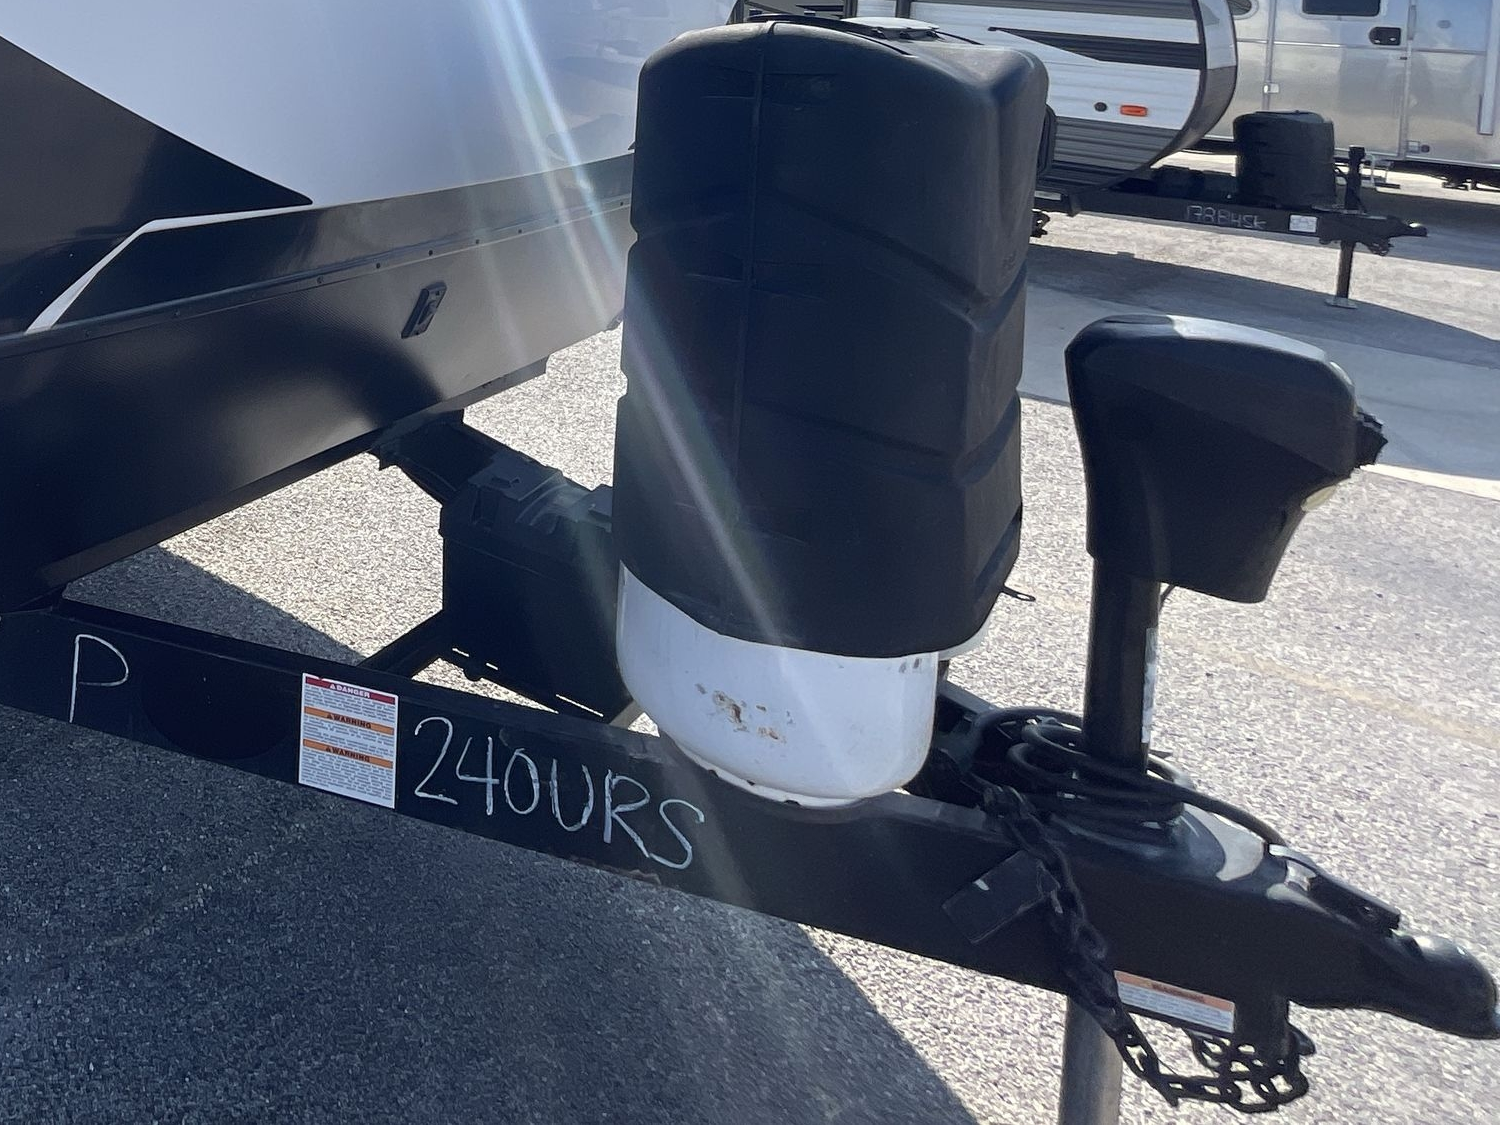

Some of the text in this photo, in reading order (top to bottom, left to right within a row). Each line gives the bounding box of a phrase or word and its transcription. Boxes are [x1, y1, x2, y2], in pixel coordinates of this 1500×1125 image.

[69, 633, 129, 724] P
[336, 684, 371, 699] DANGER
[333, 713, 372, 729] WARNING
[332, 747, 370, 762] WARNING
